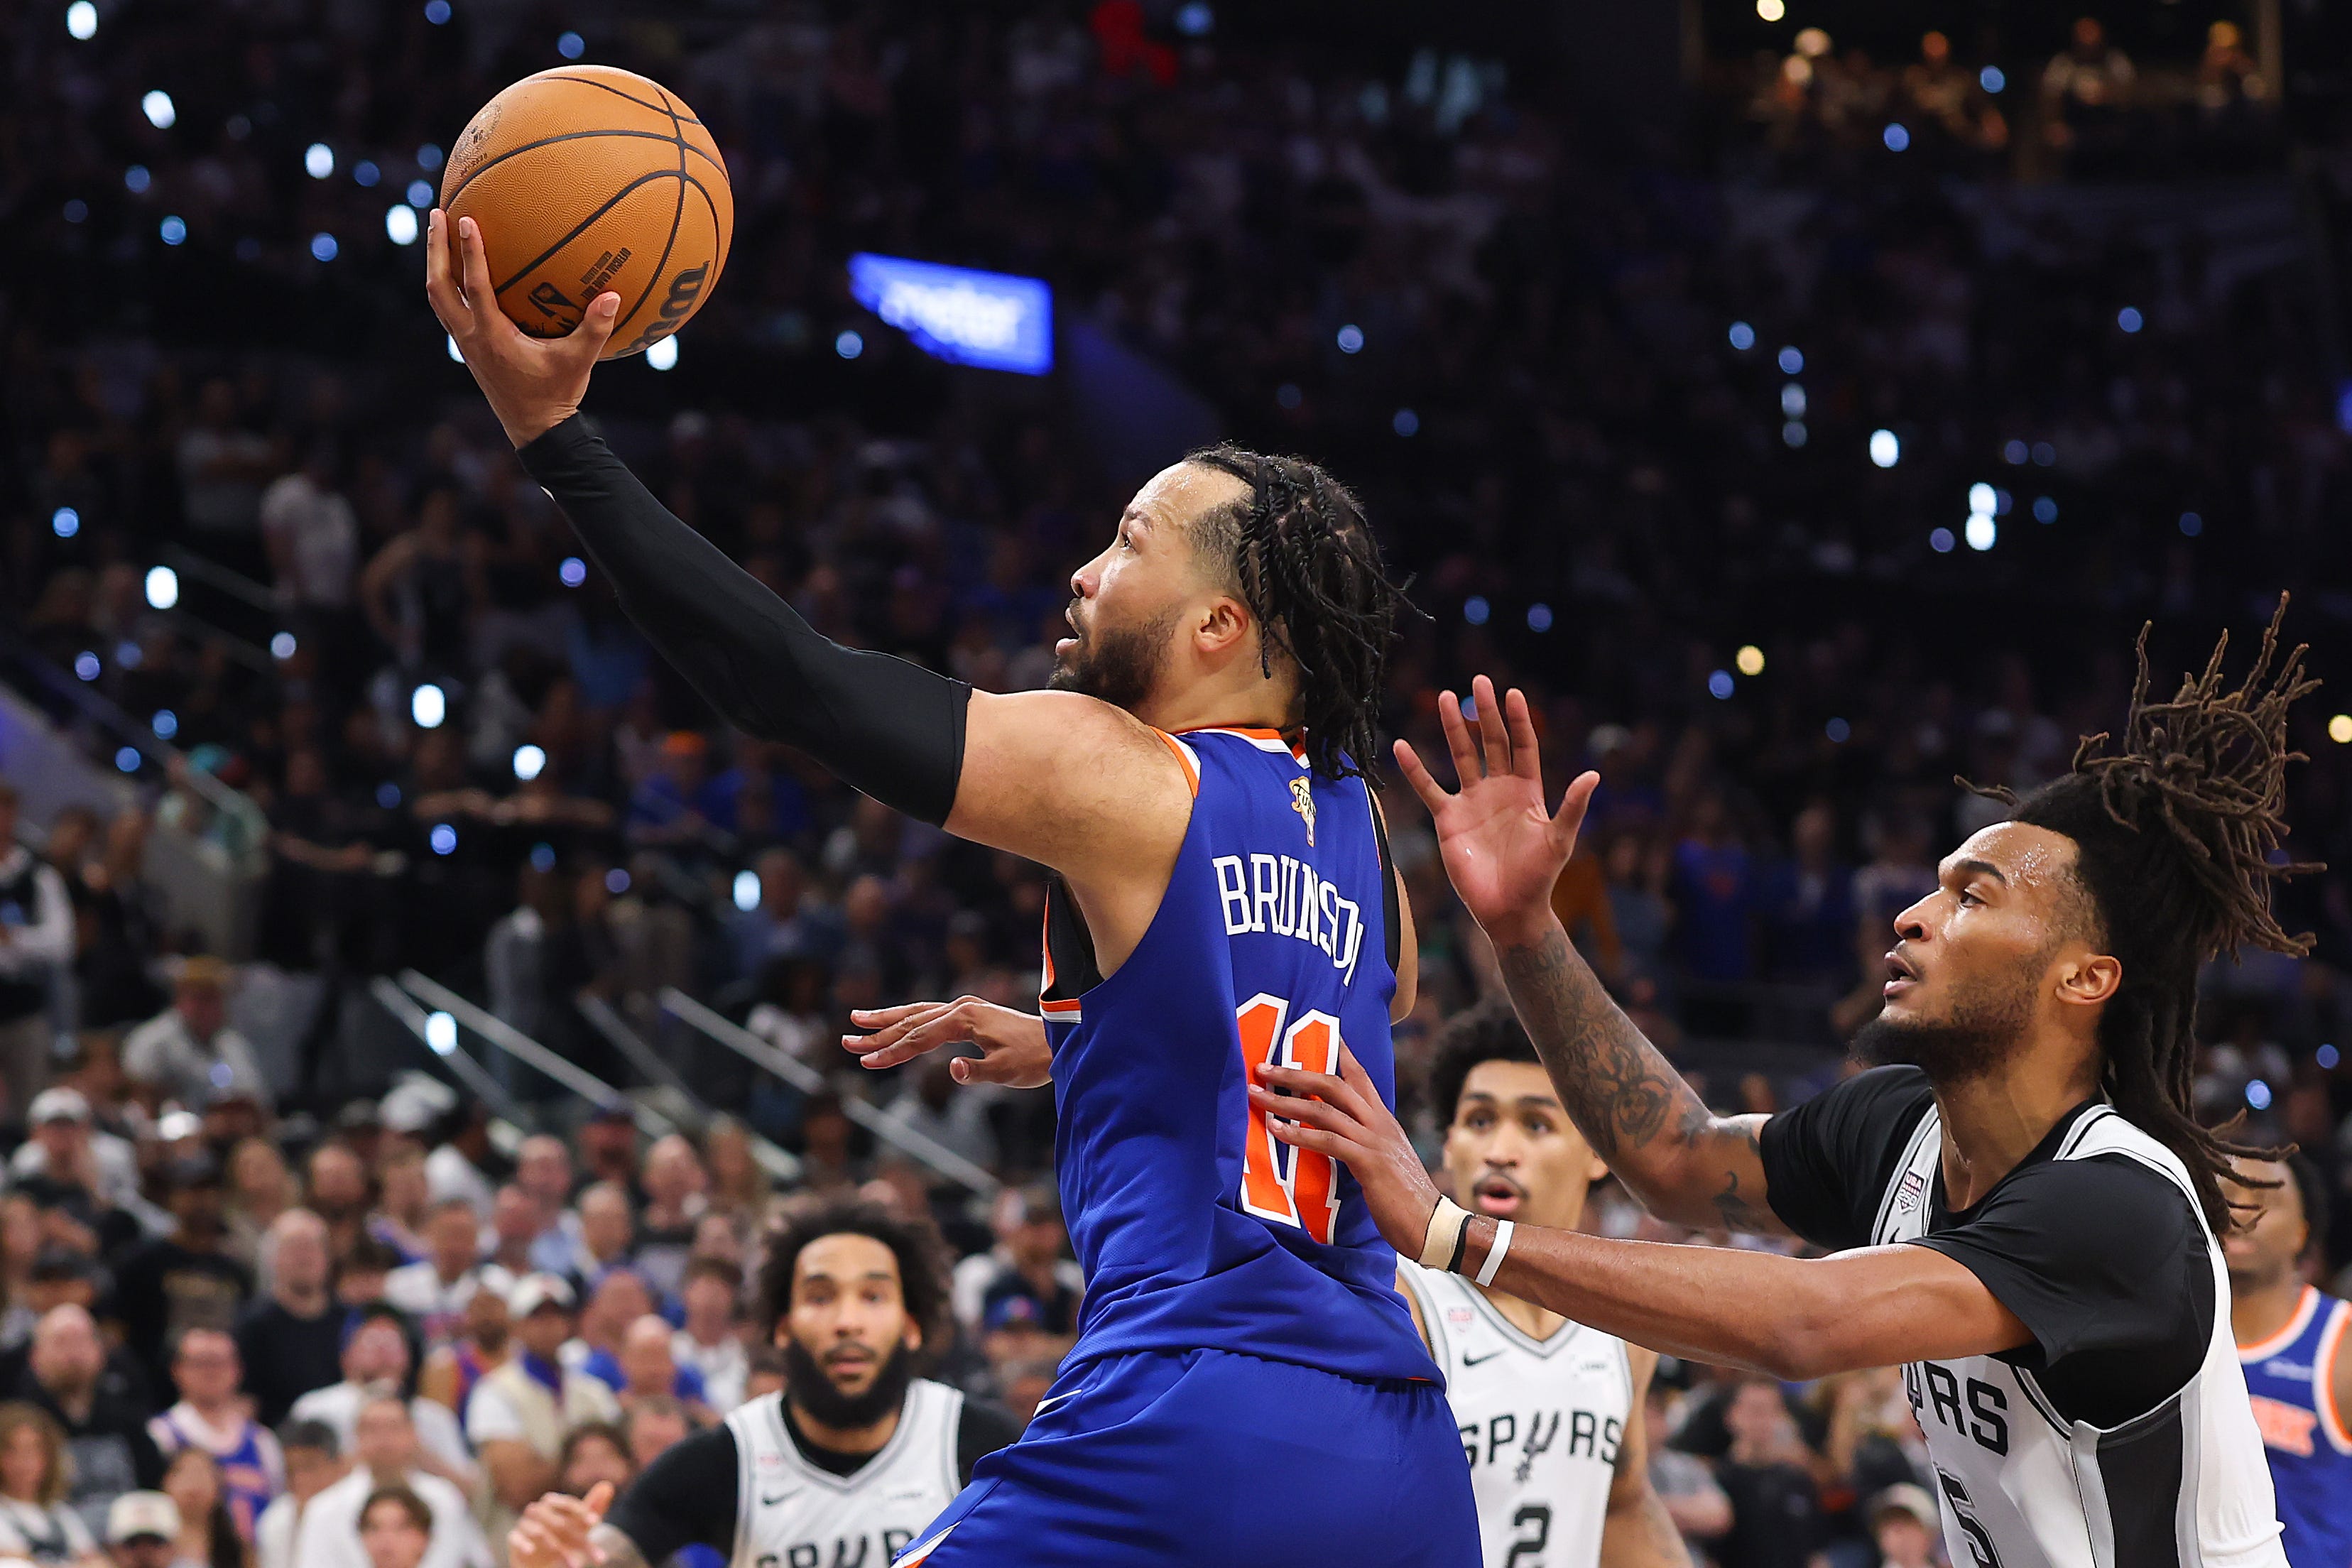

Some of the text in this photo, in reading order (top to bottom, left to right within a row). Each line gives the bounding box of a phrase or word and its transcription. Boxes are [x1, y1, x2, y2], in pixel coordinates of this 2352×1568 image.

[1236, 992, 1341, 1246] 11
[1897, 1189, 1918, 1207] 250
[1905, 1172, 1922, 1190] USA
[1506, 1506, 1552, 1568] 2
[1934, 1463, 2005, 1568] 5
